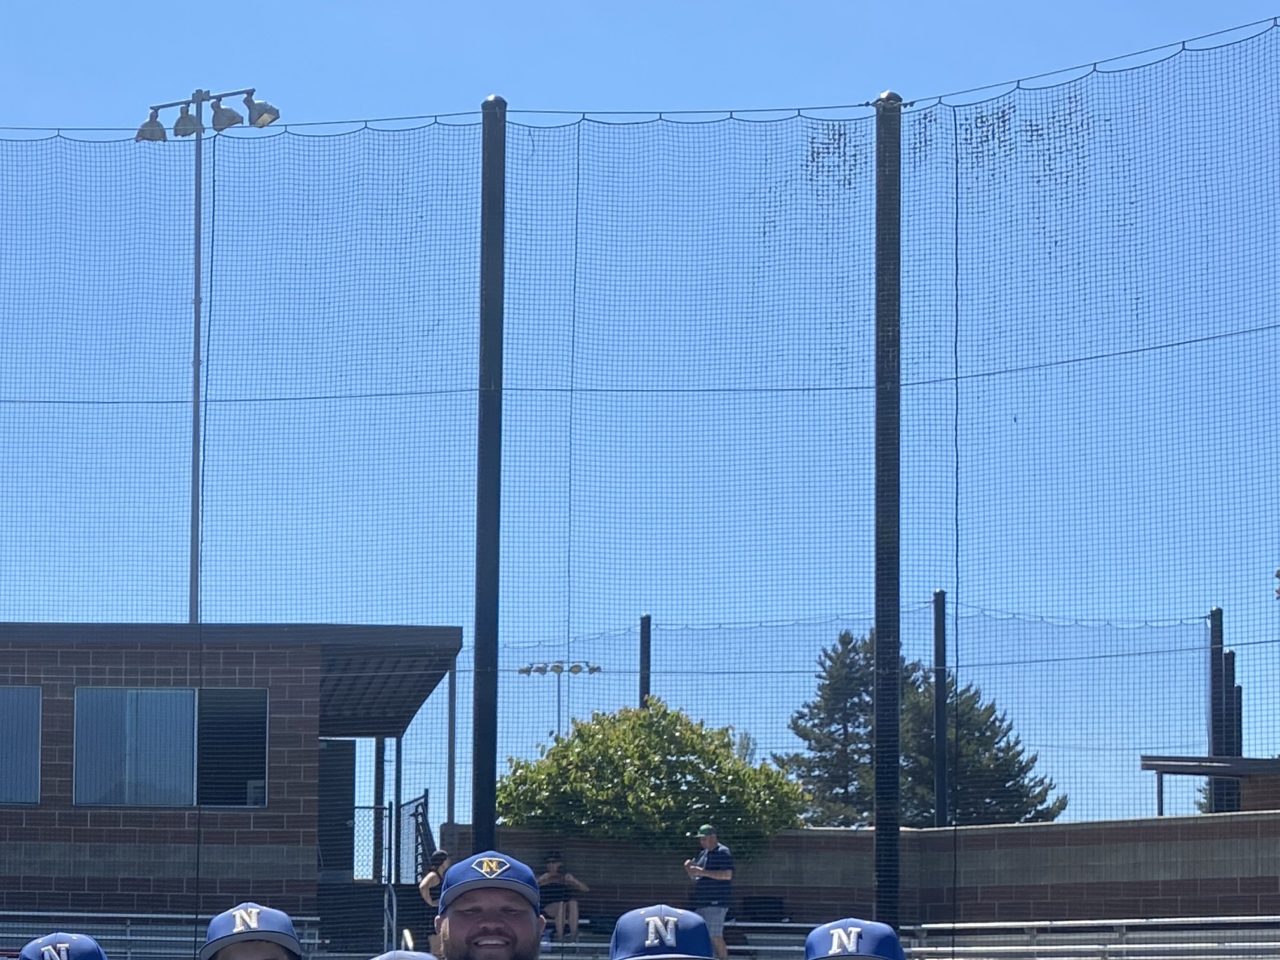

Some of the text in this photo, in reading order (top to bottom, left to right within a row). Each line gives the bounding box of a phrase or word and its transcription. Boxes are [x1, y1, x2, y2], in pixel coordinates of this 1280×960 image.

[482, 859, 500, 873] N
[232, 908, 260, 933] N
[645, 916, 678, 948] N
[828, 927, 862, 955] N
